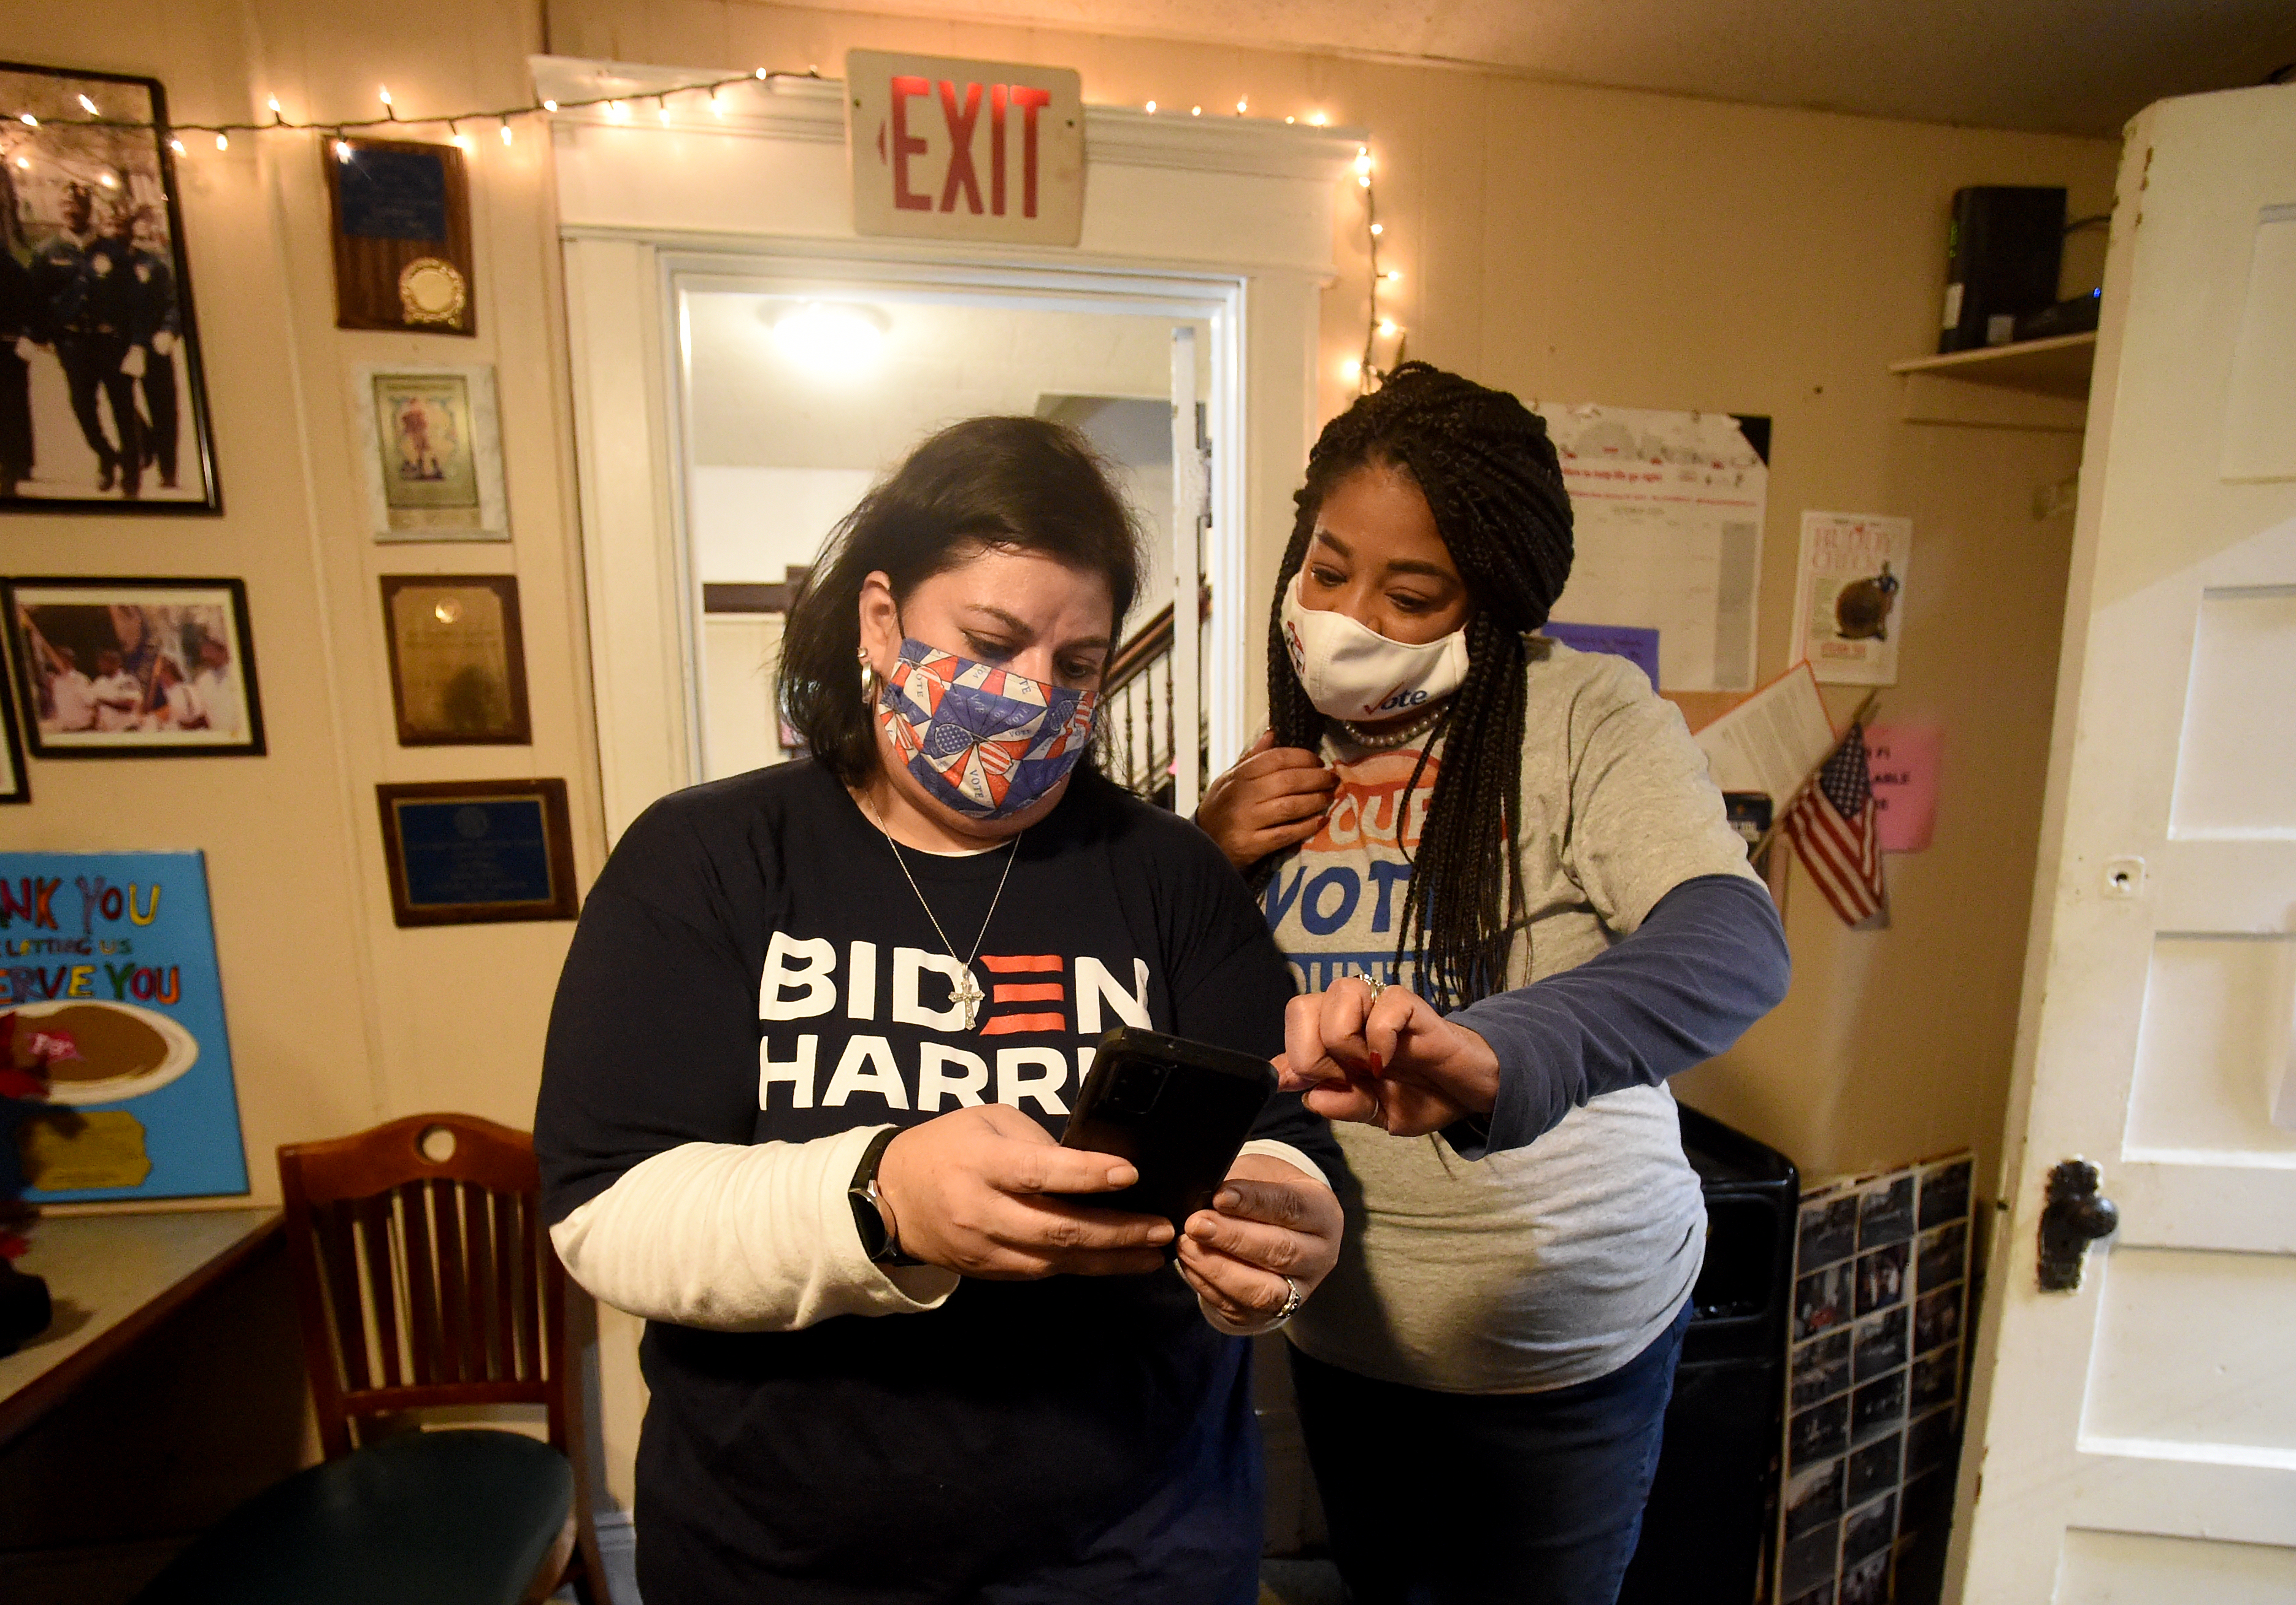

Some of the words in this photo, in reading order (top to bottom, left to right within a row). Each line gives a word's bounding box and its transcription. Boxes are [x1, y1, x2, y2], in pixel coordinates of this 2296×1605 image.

[891, 75, 1051, 219] EXIT
[1019, 679, 1031, 695] TE
[969, 769, 984, 798] VOTE
[0, 877, 62, 930] NK
[75, 876, 161, 934] YOU
[104, 963, 180, 1005] YOU
[759, 931, 1153, 1036] BIDEN
